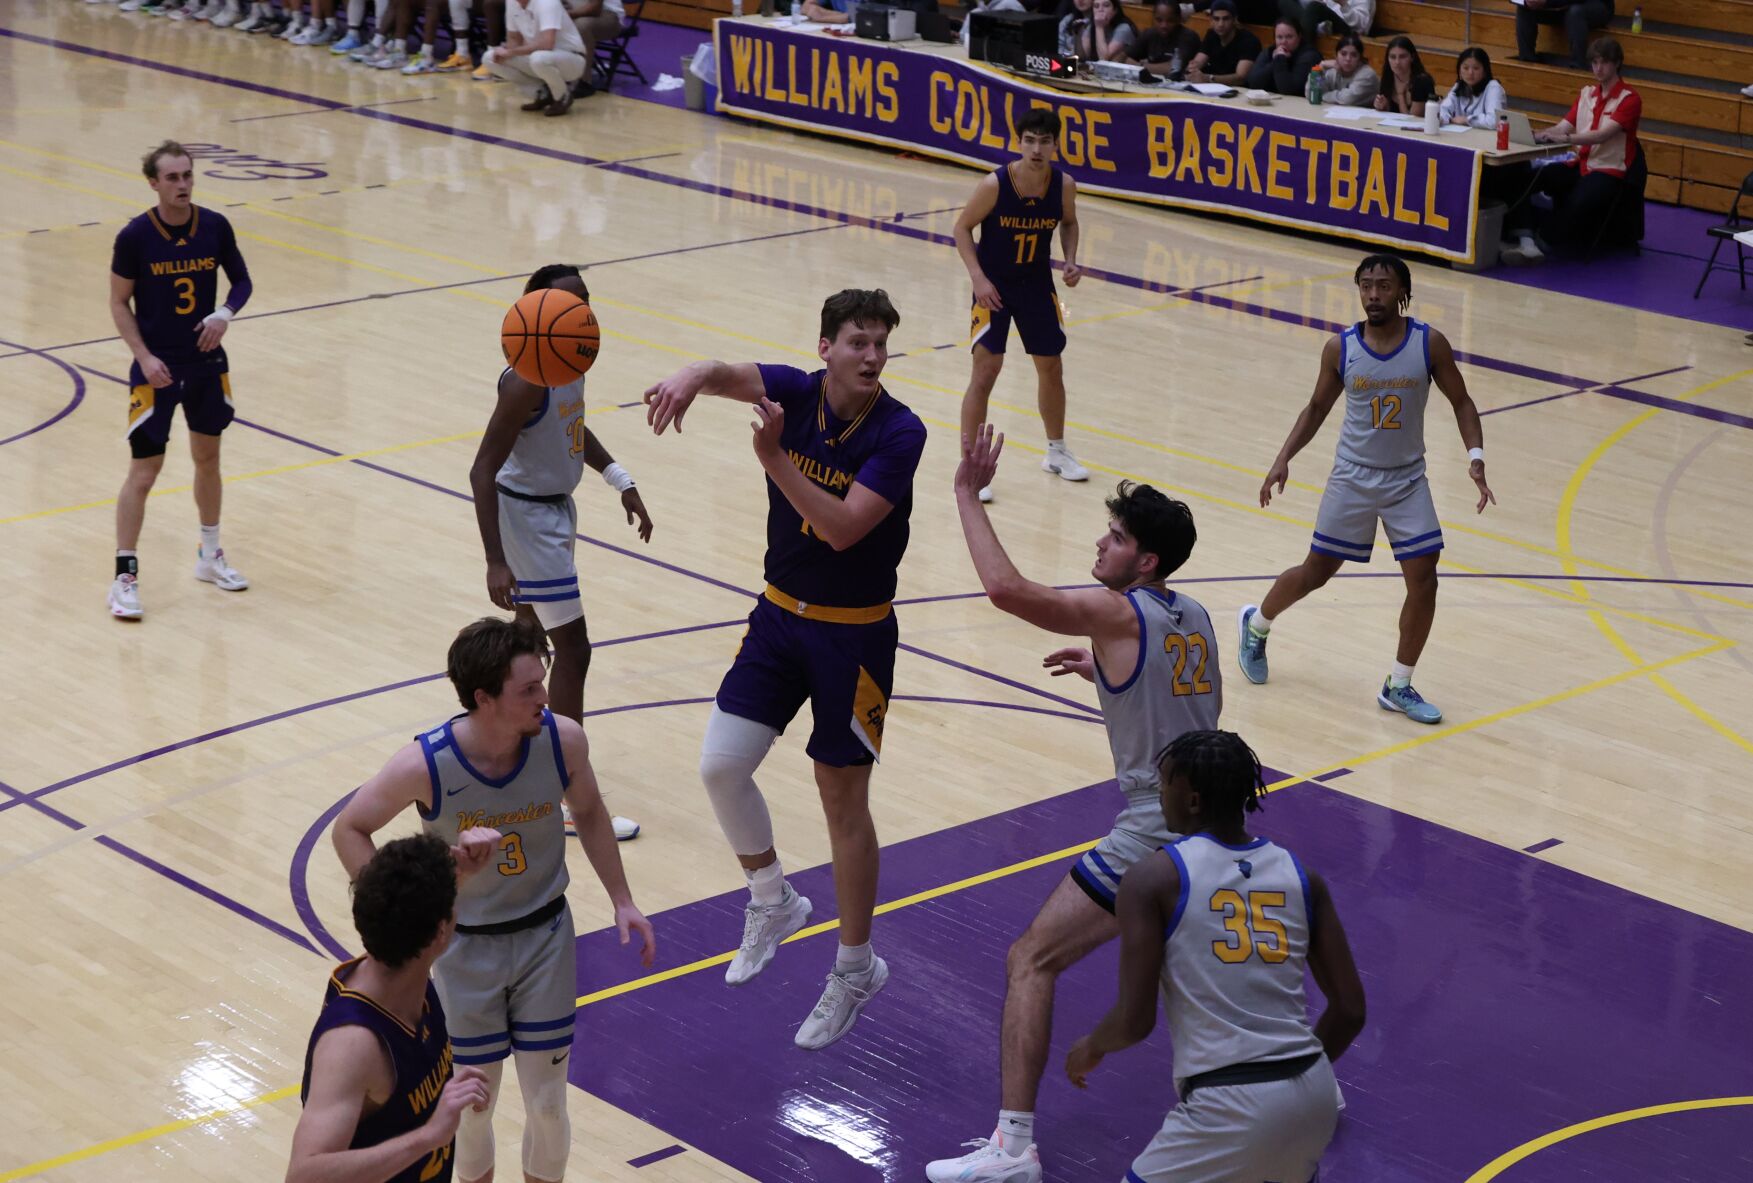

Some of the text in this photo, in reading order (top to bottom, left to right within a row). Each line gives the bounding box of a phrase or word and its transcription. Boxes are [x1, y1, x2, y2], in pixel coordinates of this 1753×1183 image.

[1025, 54, 1051, 70] POSS
[729, 34, 899, 123] WILLIAMS
[1146, 114, 1449, 231] BASKETBALL
[999, 215, 1057, 230] WILLIAMS
[150, 257, 215, 276] WILLIAMS
[1014, 233, 1039, 264] 11
[173, 277, 197, 315] 3
[1370, 394, 1402, 430] 12
[788, 448, 854, 491] WILLIAM
[1164, 631, 1212, 697] 22
[497, 831, 528, 876] 3
[1210, 888, 1290, 964] 35
